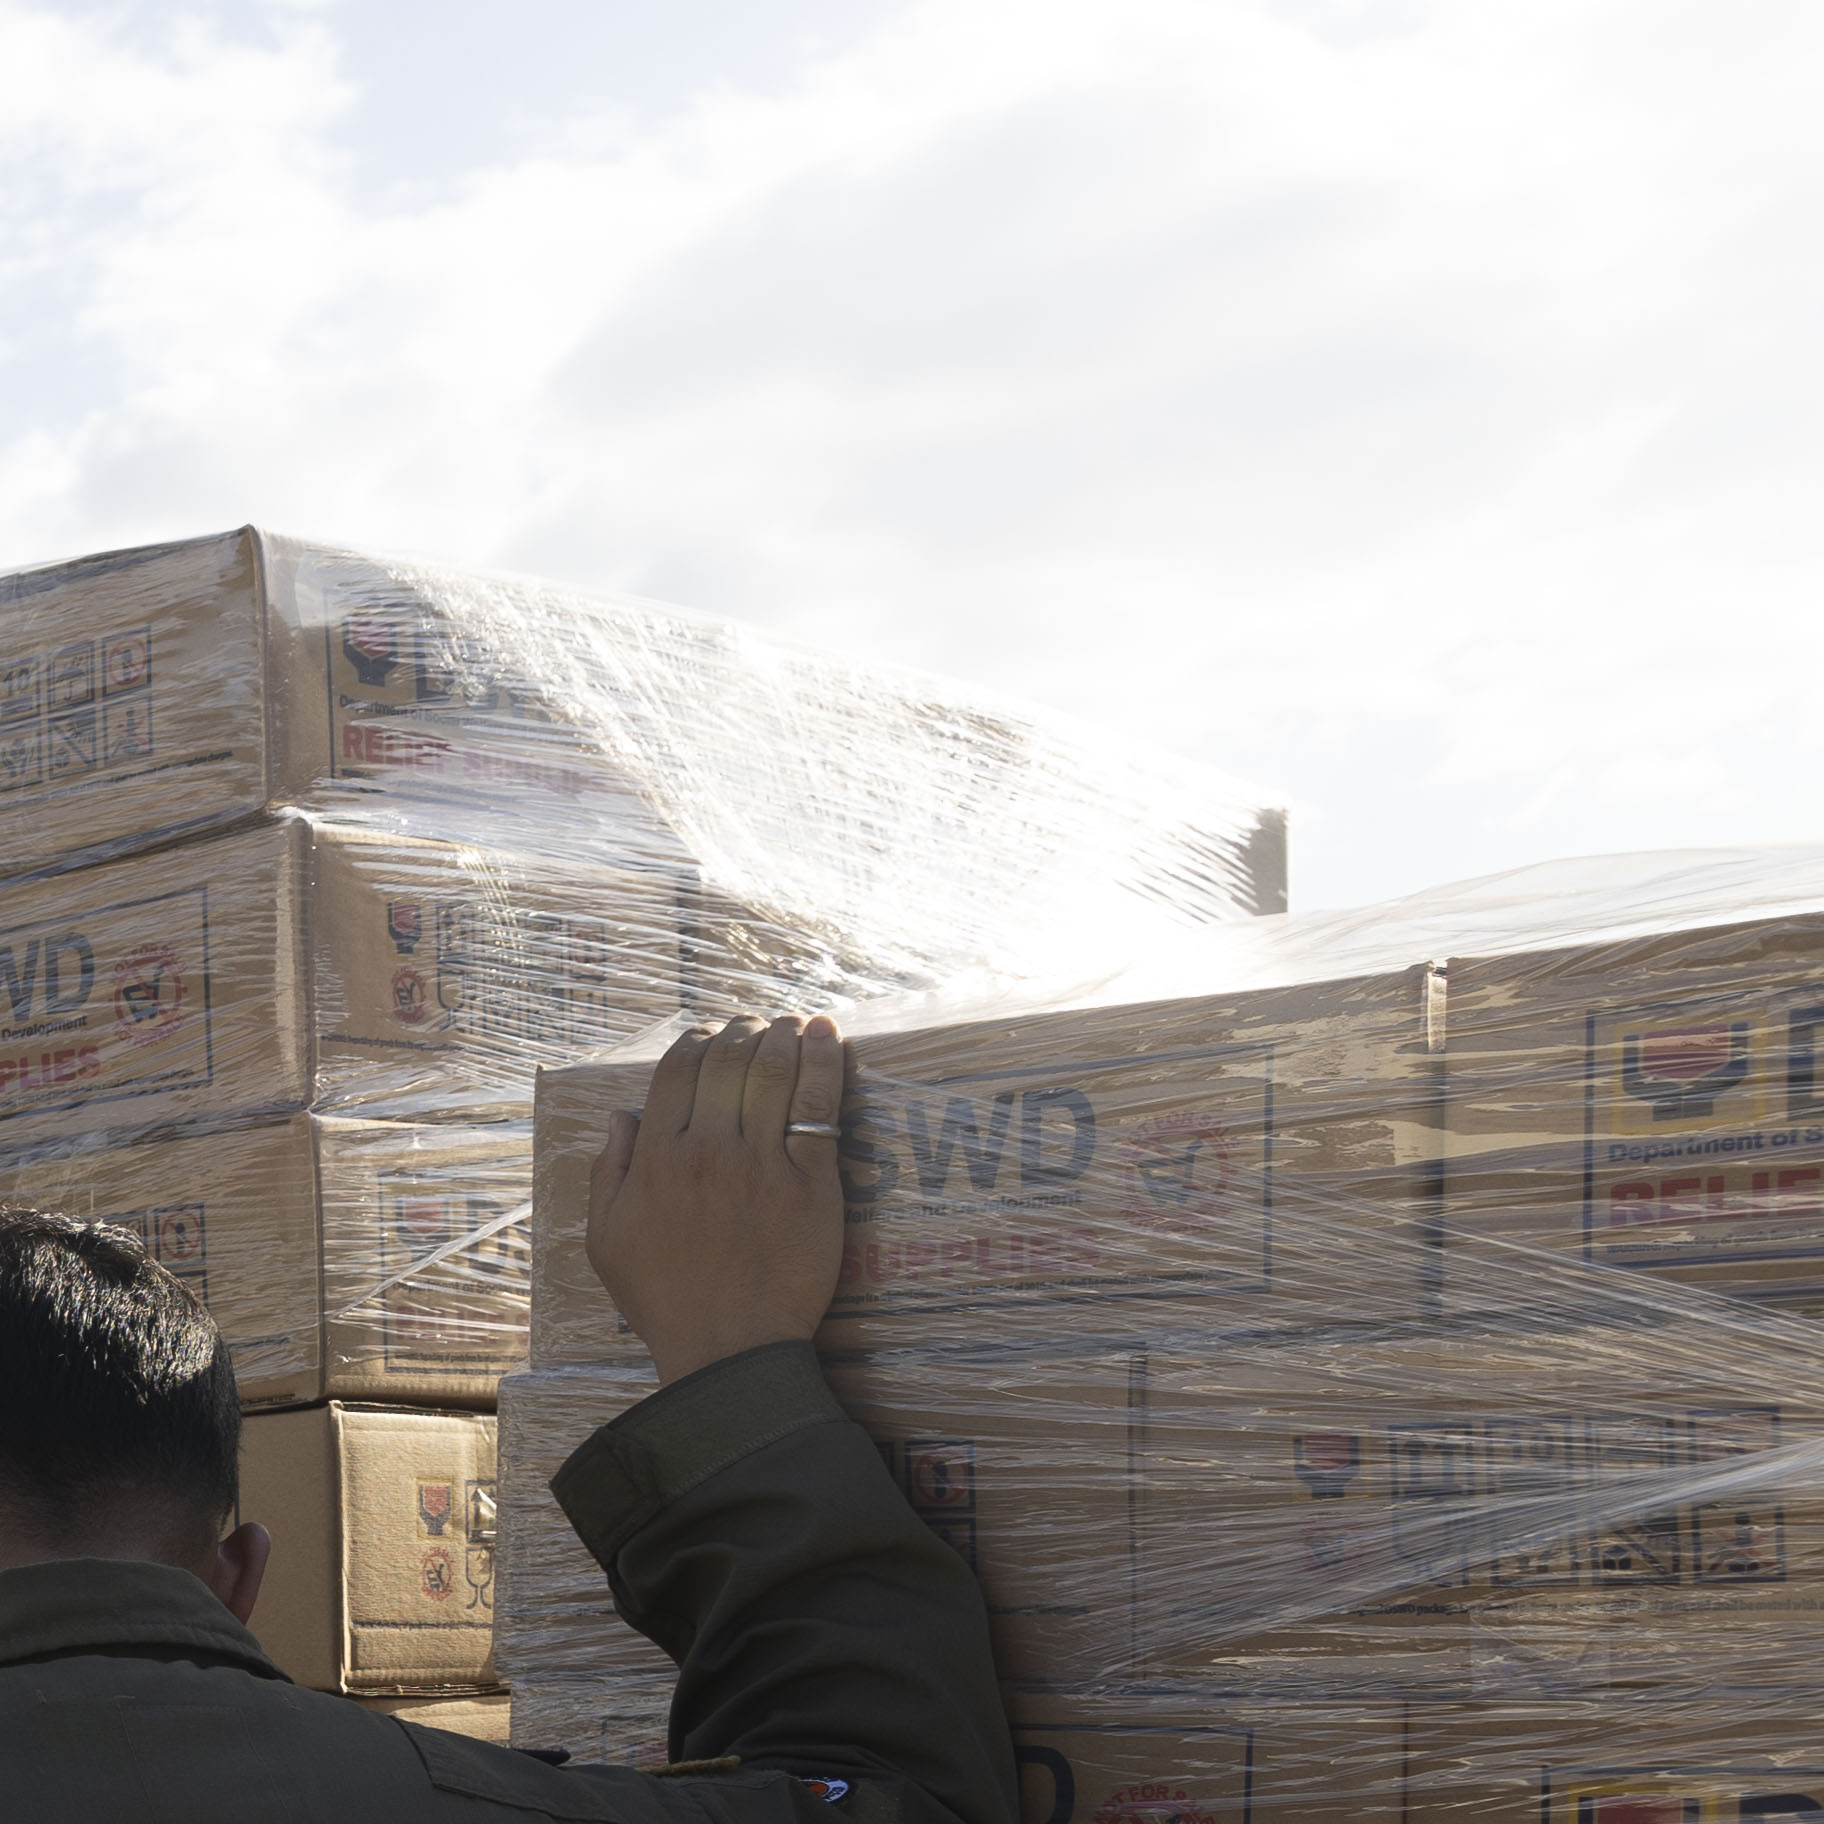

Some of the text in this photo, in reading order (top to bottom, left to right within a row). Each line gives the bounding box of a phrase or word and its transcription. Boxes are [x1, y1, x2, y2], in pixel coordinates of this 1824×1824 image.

[837, 1086, 1098, 1205] SWD
[1608, 1133, 1764, 1165] Department
[841, 1229, 1101, 1284] SUPPLIES
